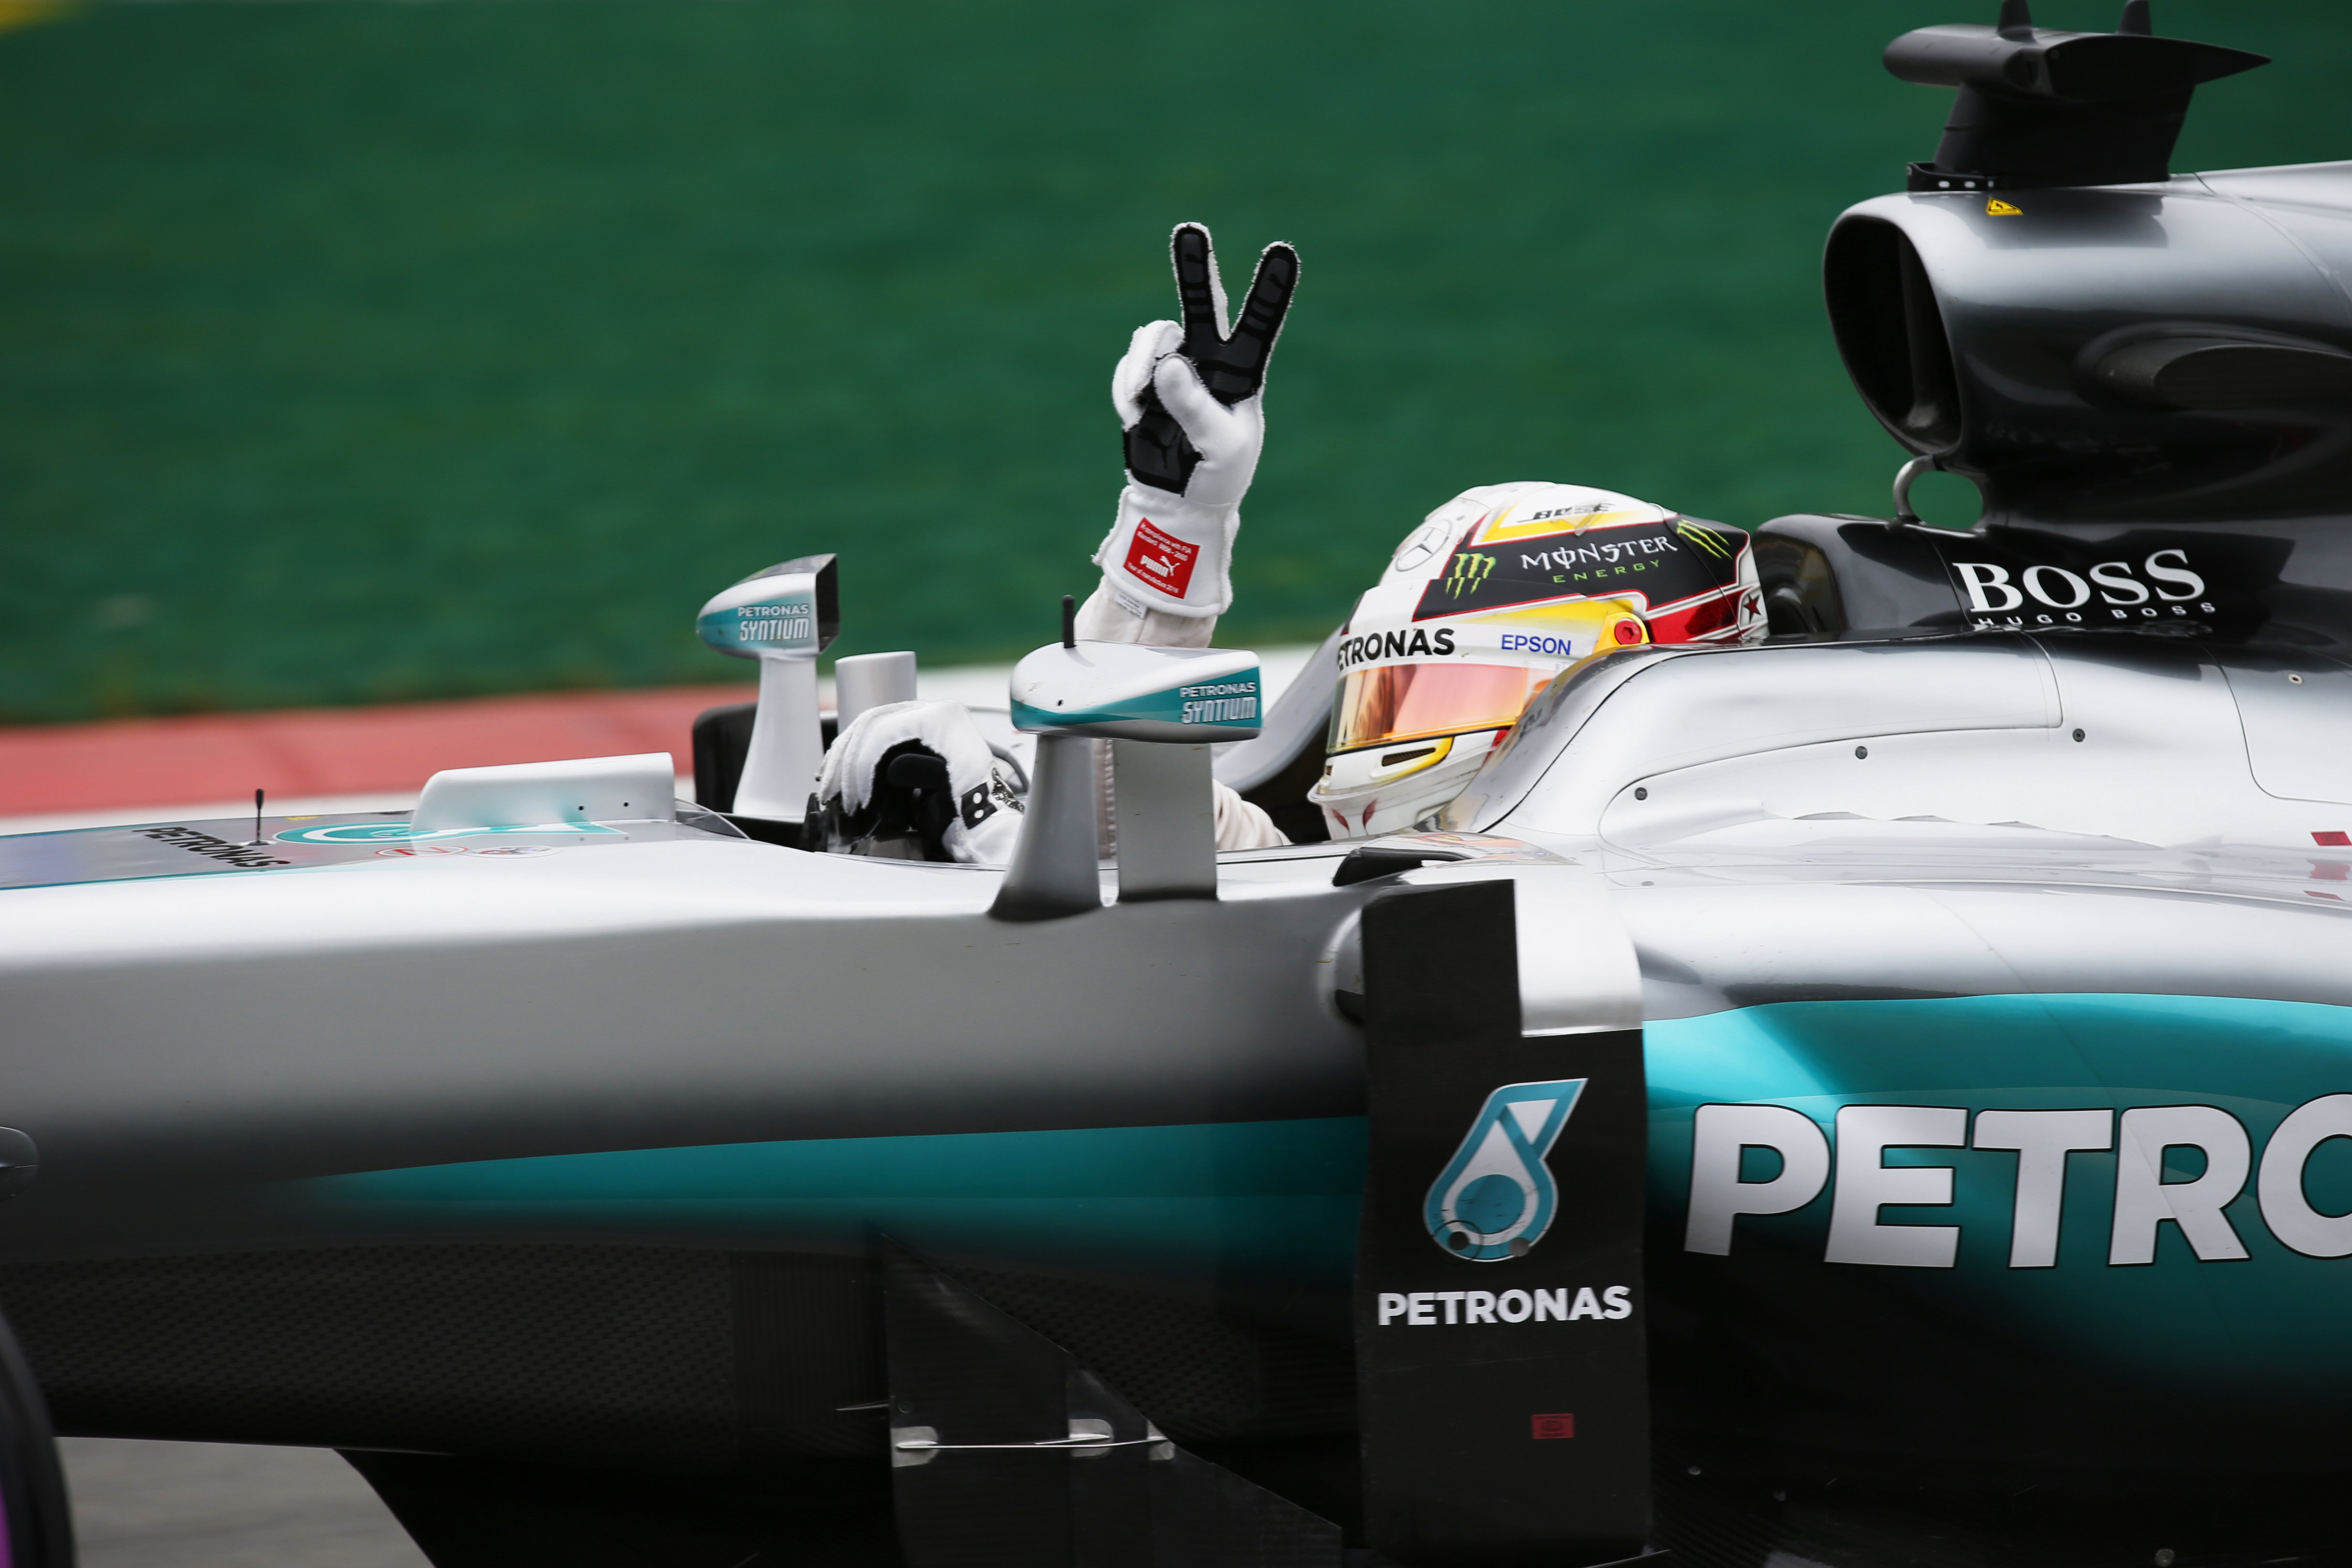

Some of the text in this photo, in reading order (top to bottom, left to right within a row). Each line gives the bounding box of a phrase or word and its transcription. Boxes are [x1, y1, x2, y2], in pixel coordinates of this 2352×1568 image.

[1520, 536, 1678, 570] MONSTER
[1140, 555, 1169, 577] PUMA
[1553, 559, 1659, 583] ENERGY
[1952, 549, 2205, 612] BOSS
[738, 604, 809, 617] PETRONAS
[1978, 602, 2215, 625] HUGO BOSS
[740, 618, 810, 641] SYNTIUM
[1502, 634, 1571, 655] EPSON
[1180, 681, 1257, 698] PETRONAS
[1182, 696, 1258, 724] SYNTIUM
[132, 826, 291, 868] PETRONAS
[1684, 1091, 2352, 1269] PETRO
[1378, 1285, 1633, 1325] PETRONAS
